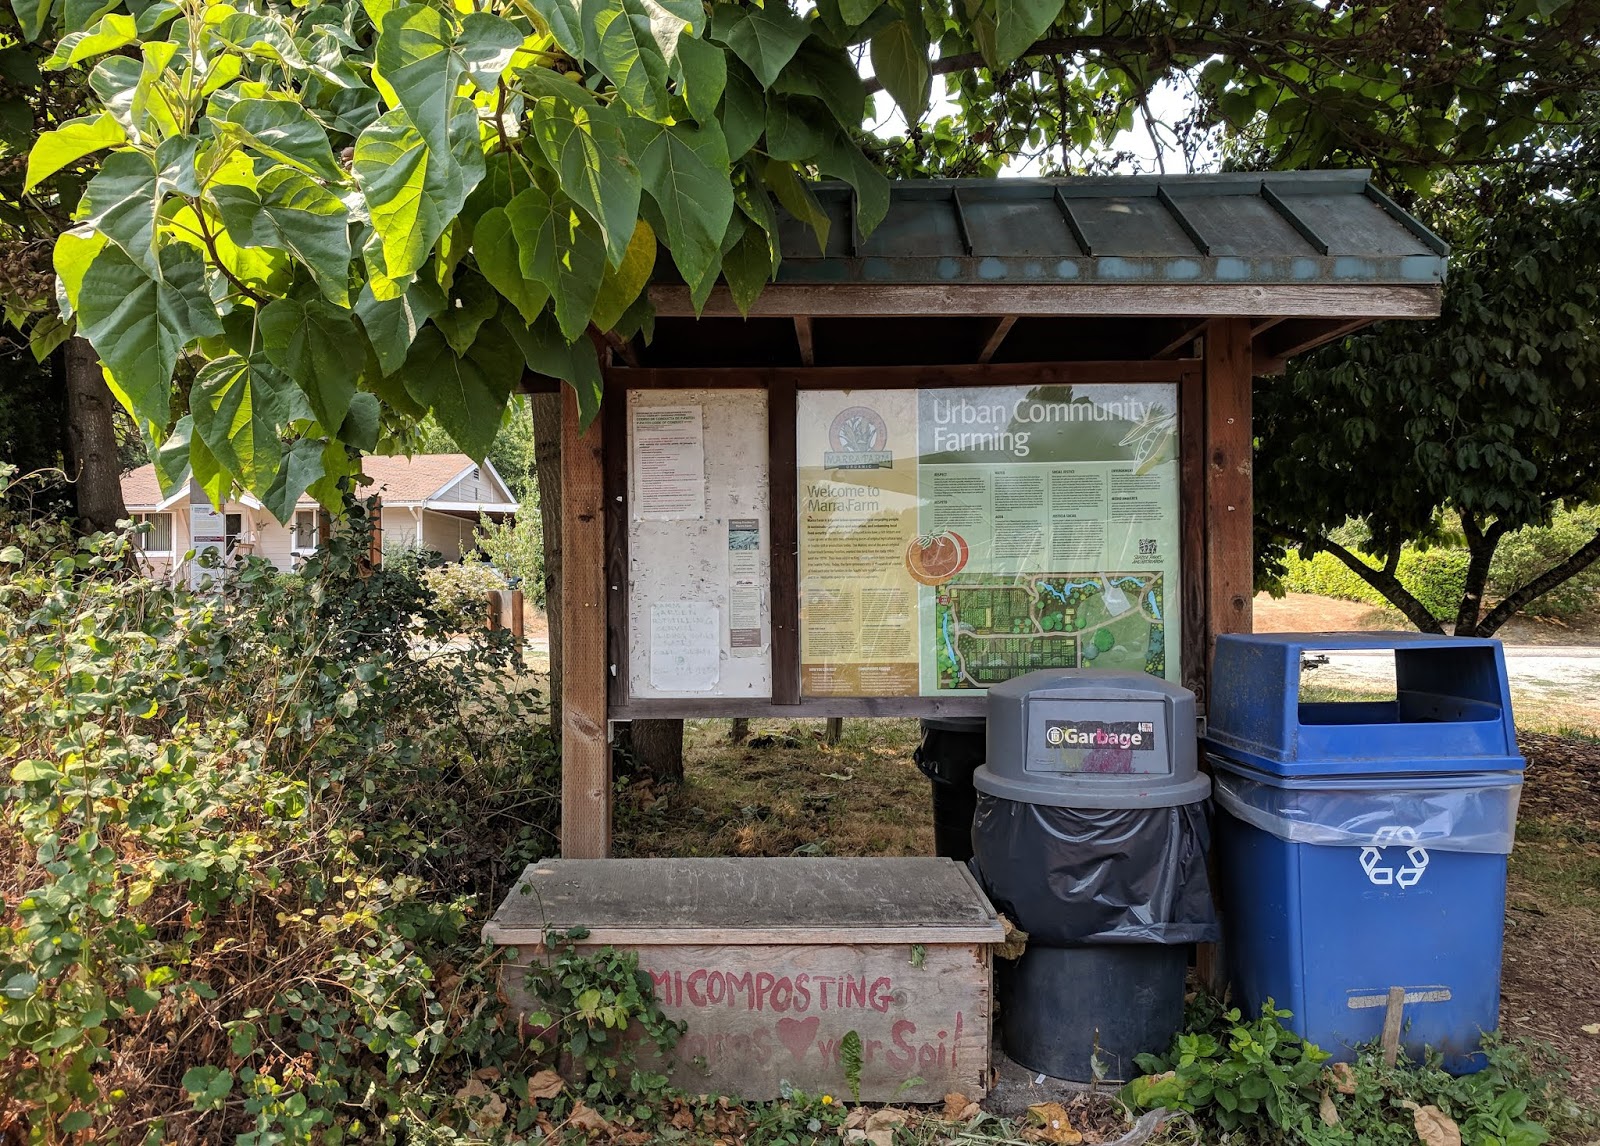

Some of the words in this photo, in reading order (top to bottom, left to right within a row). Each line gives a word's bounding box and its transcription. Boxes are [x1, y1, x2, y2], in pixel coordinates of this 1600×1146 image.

[934, 398, 1006, 424] Urban
[1013, 396, 1155, 423] Community
[934, 426, 1031, 457] Farming
[807, 485, 865, 498] Welcome
[867, 485, 880, 498] to
[808, 500, 845, 512] Marra
[847, 500, 879, 512] Farm
[1064, 728, 1142, 749] Garbage
[649, 968, 895, 1013] MICOMPOSTING
[886, 1011, 963, 1072] Soil
